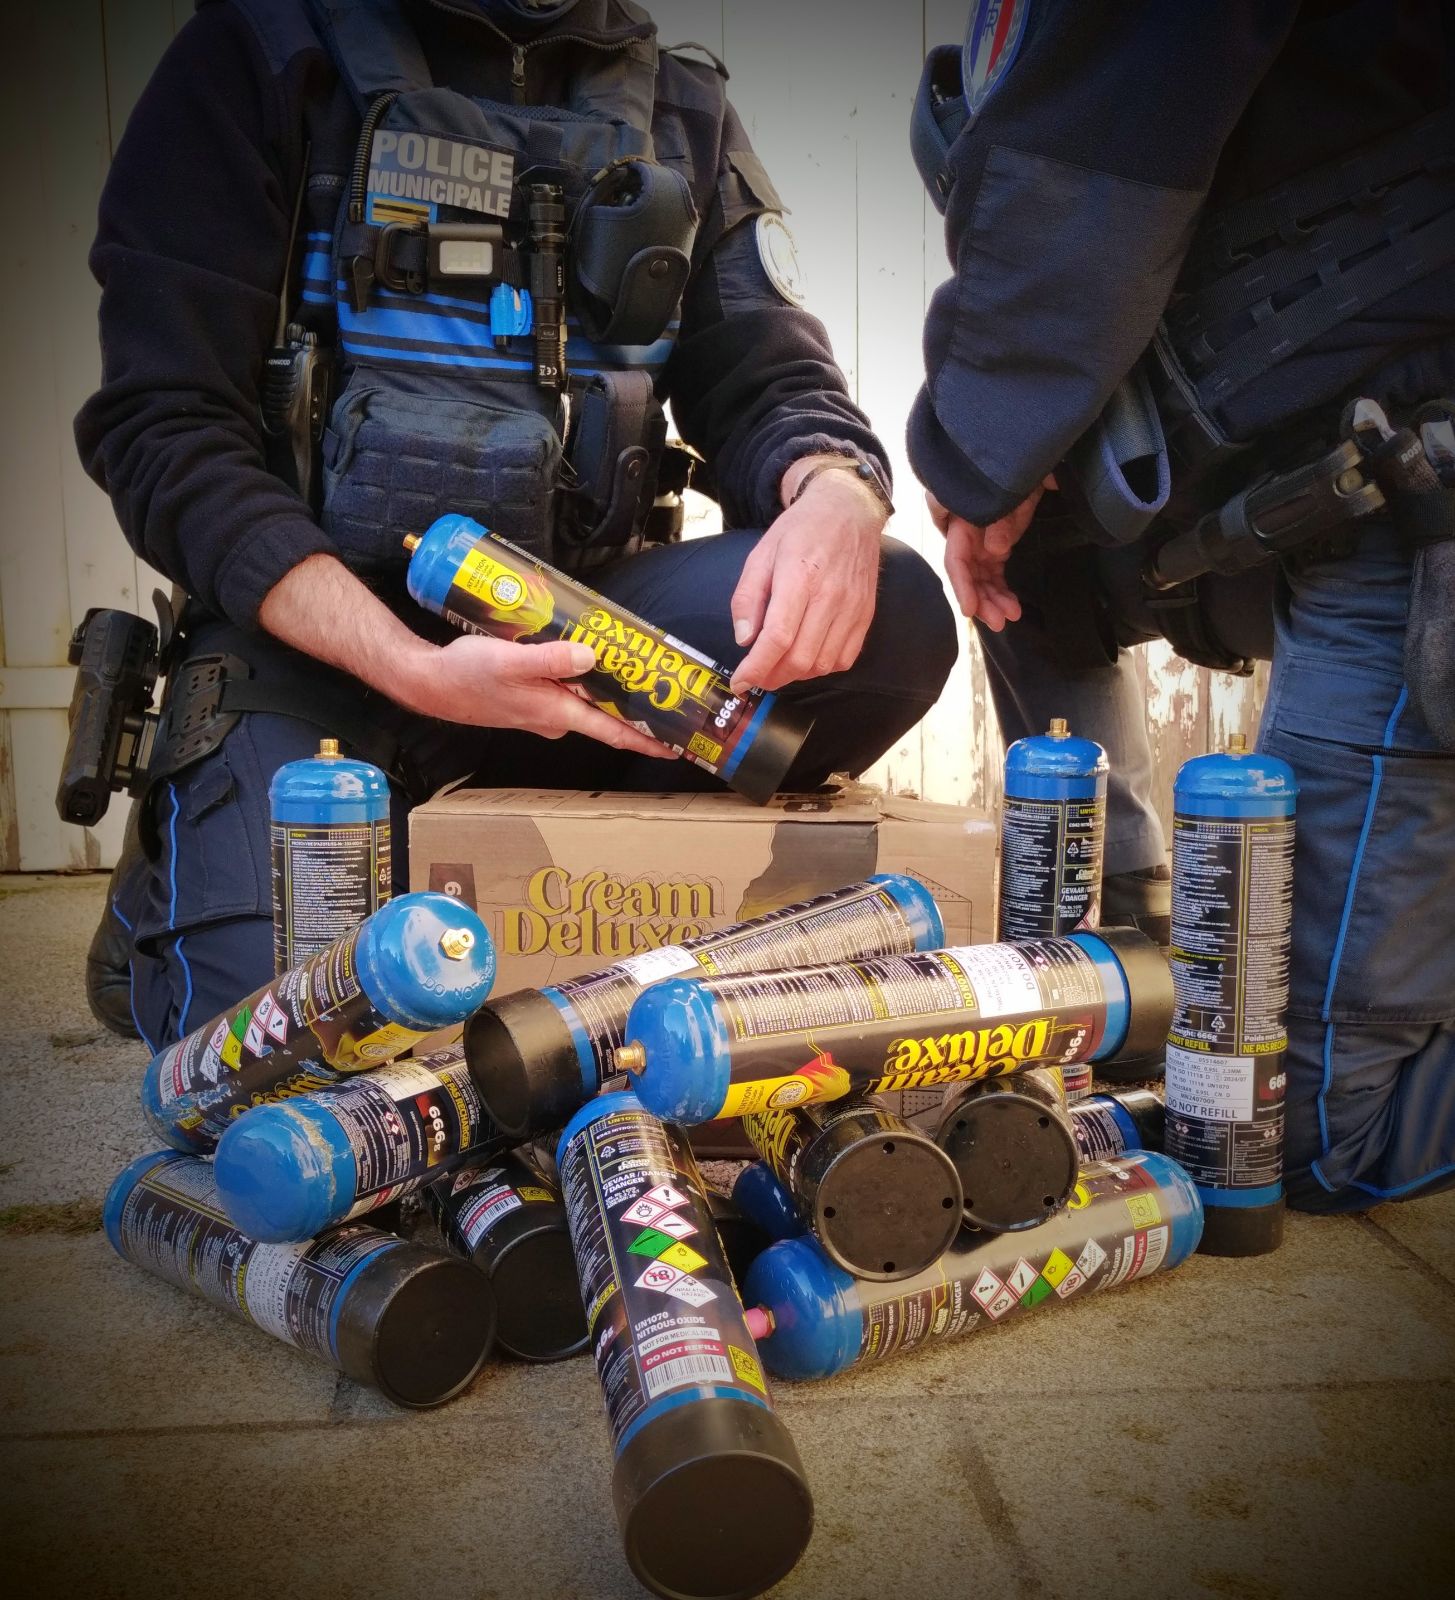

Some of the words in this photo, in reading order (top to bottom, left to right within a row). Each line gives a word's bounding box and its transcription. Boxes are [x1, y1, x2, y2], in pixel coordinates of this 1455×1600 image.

[371, 131, 514, 189] POLICE
[368, 169, 509, 218] MUNICIPALE
[466, 558, 488, 589] ATTENTION
[589, 609, 715, 699] Deluxe
[566, 622, 682, 711] Cream
[713, 696, 741, 729] 666g
[528, 866, 714, 917] Cream
[503, 906, 703, 956] Deluxe
[697, 952, 709, 965] NE
[938, 954, 961, 975] REFILL
[1007, 953, 1027, 971] NOT
[957, 974, 970, 993] NOT
[1023, 973, 1036, 991] DO
[291, 994, 303, 1029] DANGER
[963, 992, 974, 1008] DO
[895, 1020, 1050, 1071] Deluxe
[1059, 1029, 1086, 1063] 666g
[1185, 1039, 1211, 1051] REFILL
[1242, 1044, 1255, 1054] NE
[1255, 1042, 1270, 1053] PAS
[448, 1081, 460, 1099] PAS
[456, 1097, 471, 1149] RECHARGER
[1168, 1096, 1178, 1108] DO
[1178, 1101, 1199, 1115] NOT
[1200, 1107, 1239, 1119] REFILL
[428, 1105, 446, 1152] 666g
[608, 1116, 642, 1125] UN1070
[479, 1183, 499, 1198] OXIDE
[602, 1172, 636, 1190] GEVAAR
[642, 1170, 678, 1180] DANGER
[472, 1207, 486, 1222] NOT
[278, 1248, 301, 1292] REFILL
[277, 1297, 286, 1320] NOT
[953, 1281, 962, 1315] DANGER
[634, 1311, 669, 1331] UN1070
[636, 1318, 676, 1340] NITROUS
[676, 1316, 706, 1325] OXIDE
[642, 1340, 655, 1352] NOT
[656, 1335, 670, 1345] FOR
[670, 1331, 700, 1339] MEDICAL
[646, 1354, 661, 1366] DO
[661, 1347, 683, 1358] NOT
[684, 1343, 720, 1352] REFILL
